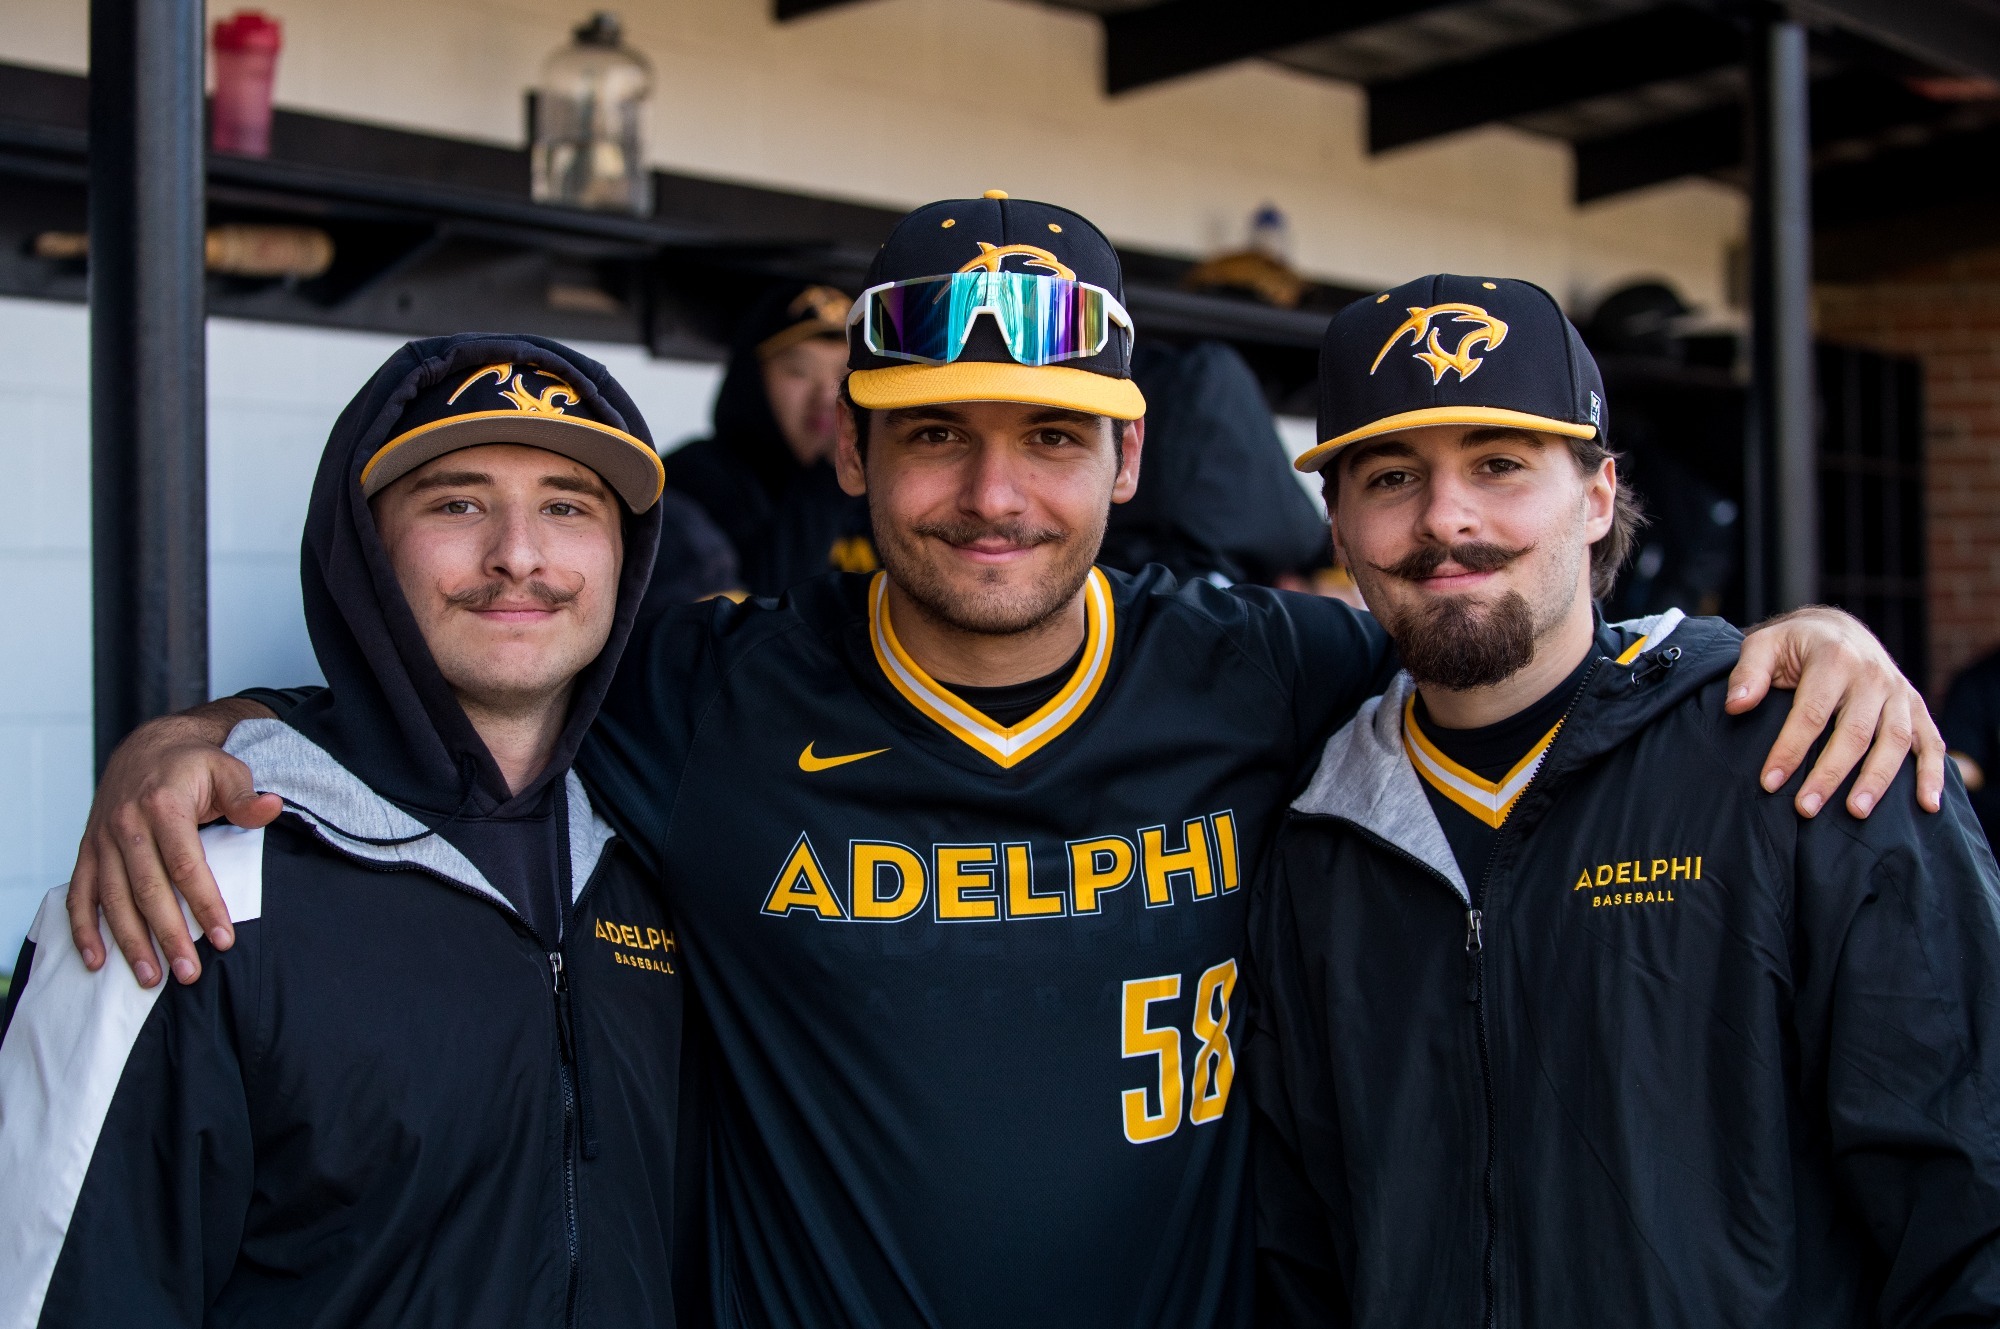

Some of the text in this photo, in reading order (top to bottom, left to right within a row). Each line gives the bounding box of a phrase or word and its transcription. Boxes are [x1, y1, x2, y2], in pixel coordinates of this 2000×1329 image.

[760, 809, 1240, 923] ADELPHI
[1573, 856, 1702, 891] ADELPHI
[1592, 890, 1675, 908] BASEBALL
[595, 917, 679, 953] ADELPH
[614, 951, 675, 975] BASEBALL
[1120, 957, 1238, 1144] 58
